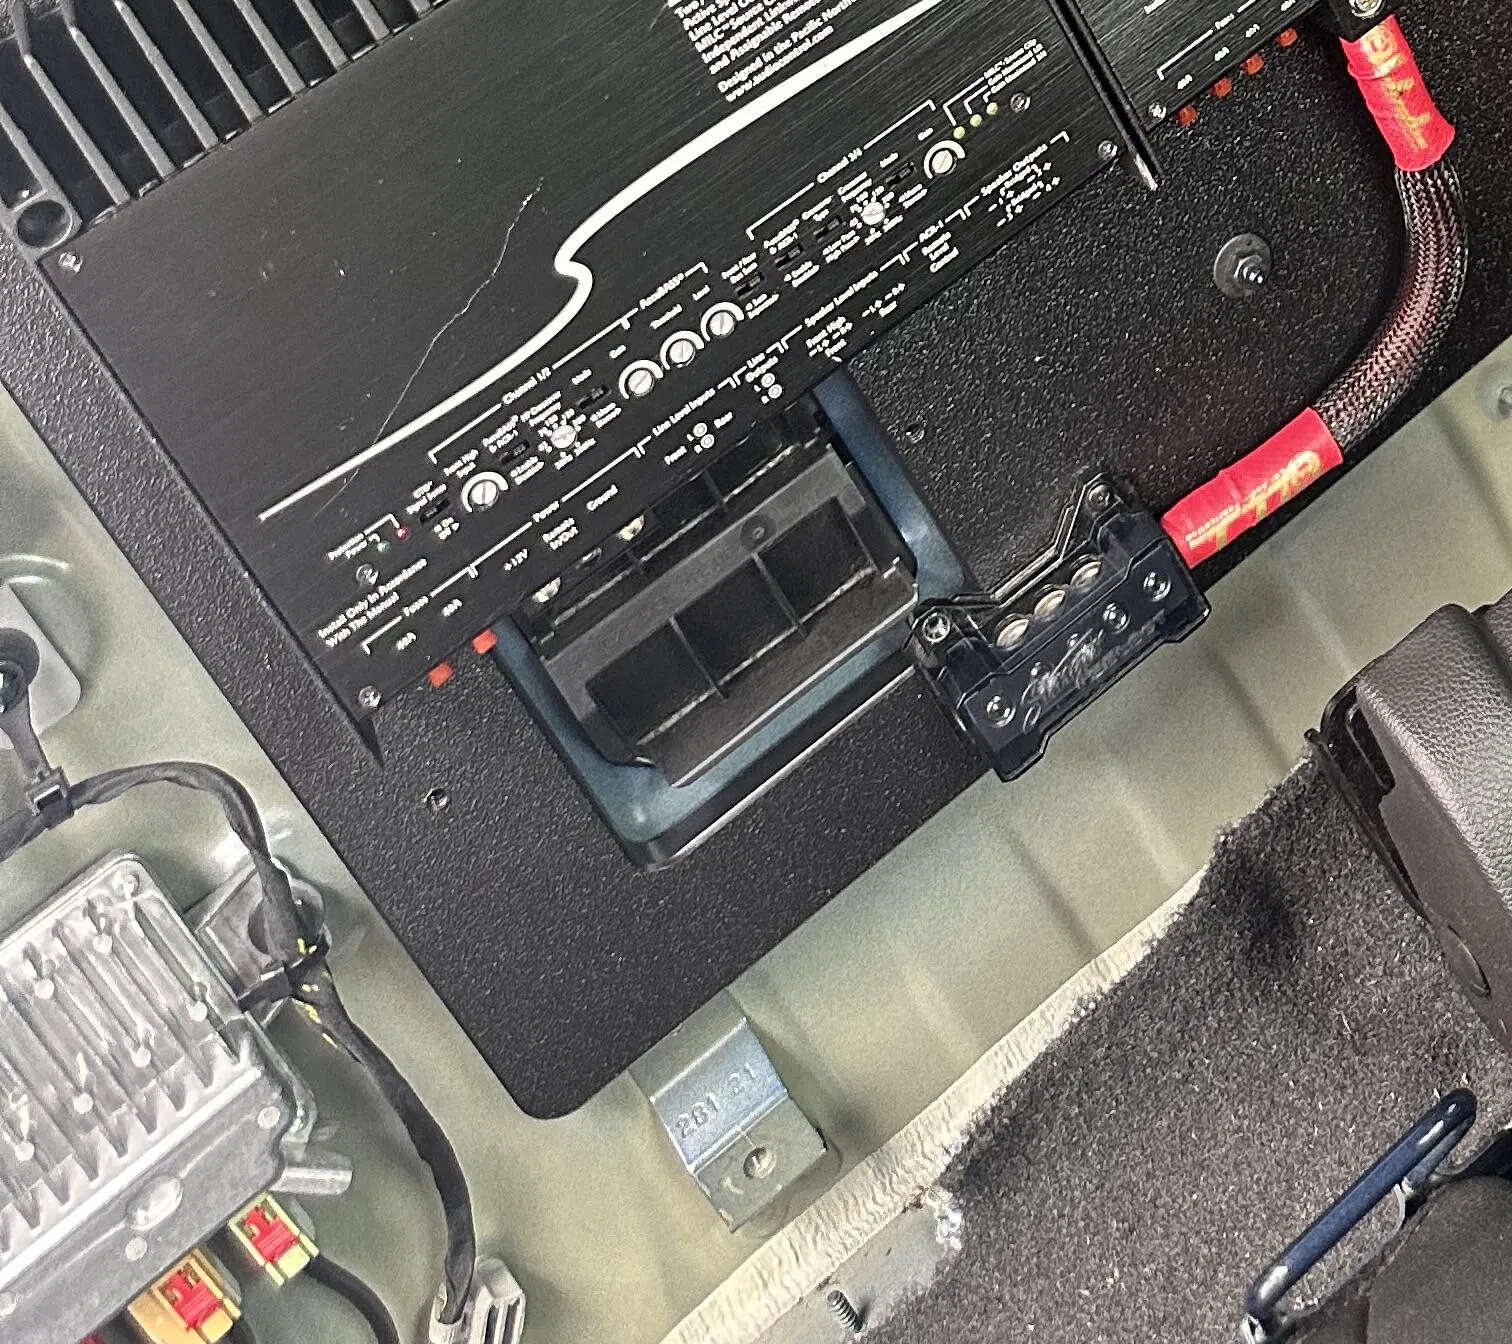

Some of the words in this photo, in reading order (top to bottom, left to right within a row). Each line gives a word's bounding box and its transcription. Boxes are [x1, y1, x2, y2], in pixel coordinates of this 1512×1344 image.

[673, 0, 699, 18] Two
[681, 3, 717, 30] Active
[687, 21, 712, 41] Line
[710, 1, 739, 26] Level
[728, 2, 764, 30] Source
[701, 16, 765, 63] Independent
[708, 53, 730, 74] and
[727, 20, 783, 60] Assignable
[717, 56, 763, 93] Designed
[772, 38, 792, 55] the
[789, 17, 823, 43] Pacific
[725, 25, 833, 102] www.audiocontrol.com
[816, 155, 849, 183] Channel
[980, 169, 1012, 196] Speaker
[1011, 143, 1048, 175] Outputs
[501, 375, 537, 405] Channel
[651, 419, 671, 436] Line
[668, 403, 691, 424] Level
[688, 387, 715, 410] Inputs
[317, 613, 349, 638] Install
[345, 599, 368, 619] Only
[366, 591, 379, 604] In
[377, 558, 427, 596] Accordance
[324, 627, 351, 647] With
[347, 615, 367, 631] The
[365, 591, 399, 620] Manual
